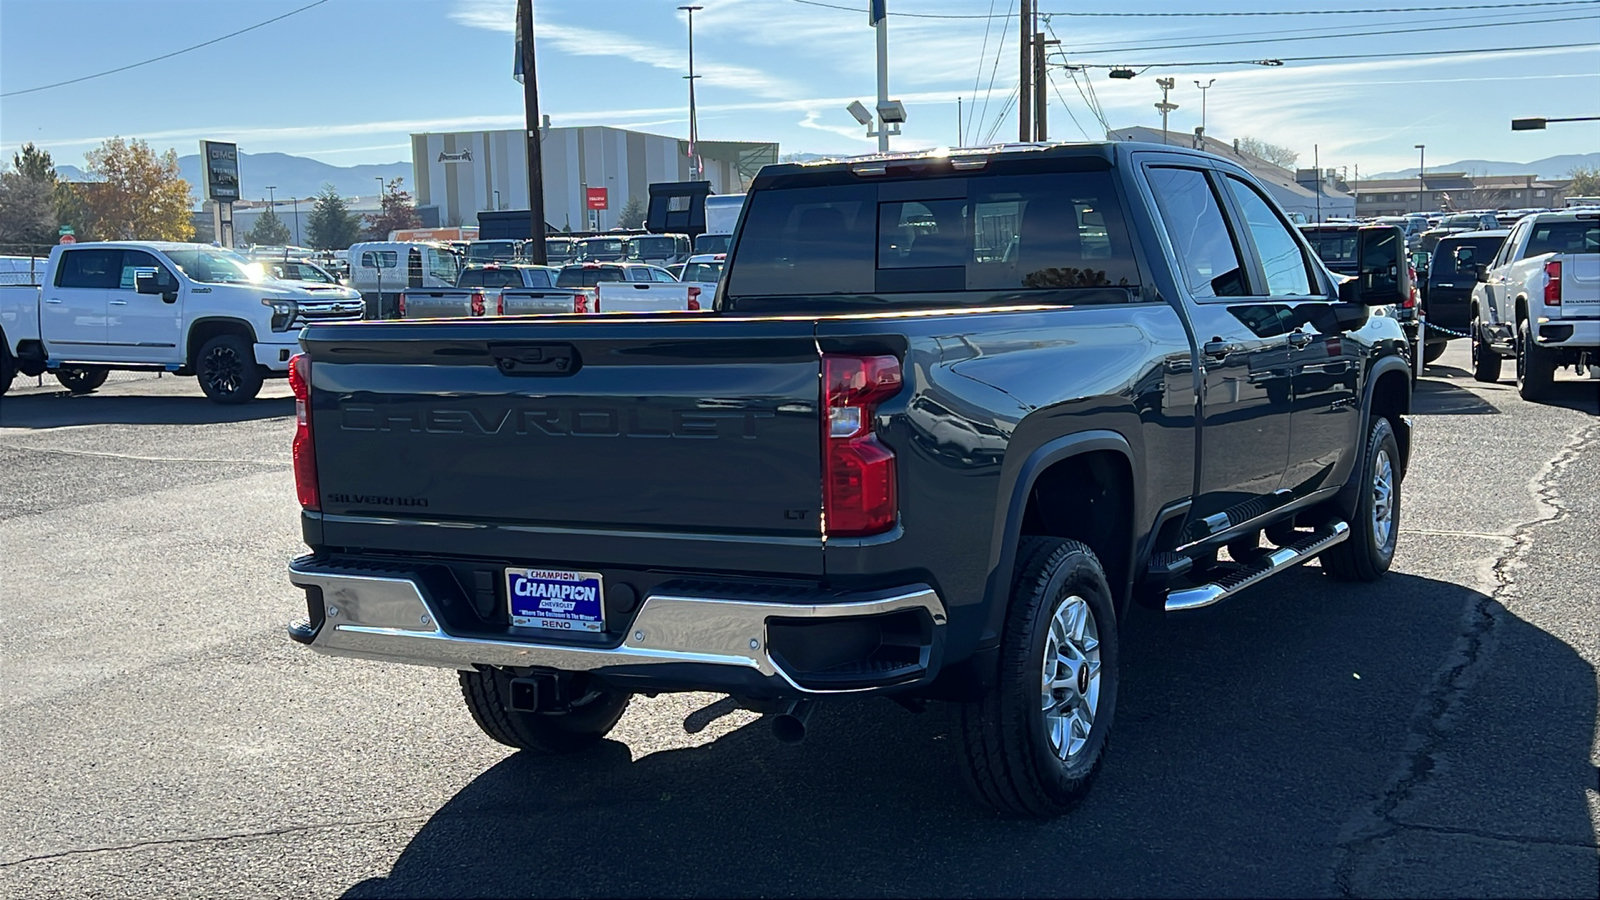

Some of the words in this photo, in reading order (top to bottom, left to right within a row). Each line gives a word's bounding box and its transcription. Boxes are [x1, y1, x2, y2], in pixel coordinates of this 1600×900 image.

[212, 150, 235, 159] GMC
[339, 406, 777, 440] CHEVROLET
[327, 493, 429, 507] SILVERADO
[784, 509, 809, 520] LT
[531, 571, 575, 580] CHAMPION
[514, 578, 596, 602] CHAMPION
[541, 601, 573, 609] CHEVROLET
[541, 620, 571, 629] RENO
